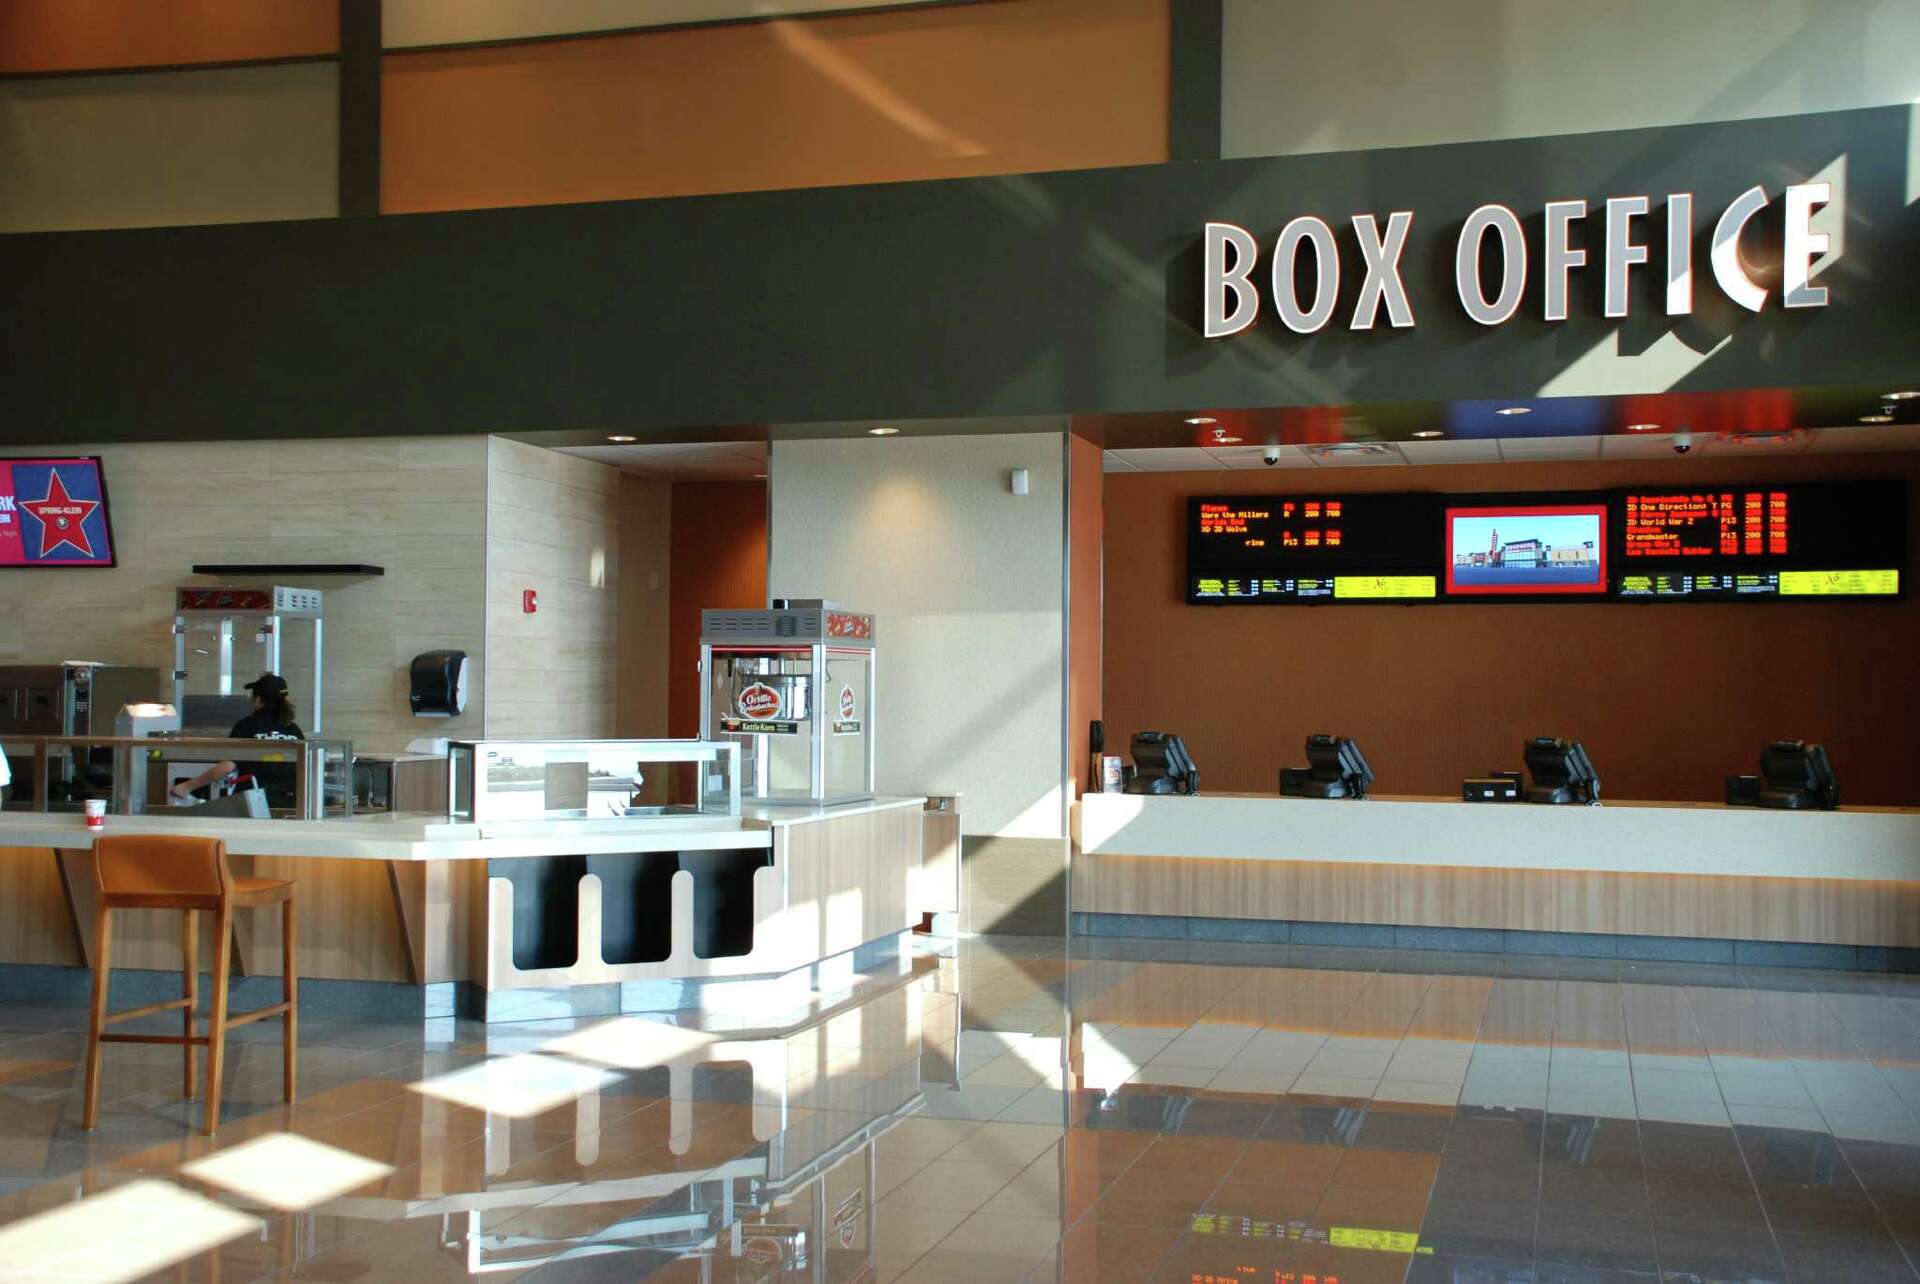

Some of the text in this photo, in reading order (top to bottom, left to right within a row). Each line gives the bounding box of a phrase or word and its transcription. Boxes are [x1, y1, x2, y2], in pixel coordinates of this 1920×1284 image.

[1204, 182, 1831, 338] BOX OFFICE
[1640, 503, 1656, 511] One
[1238, 511, 1269, 519] Millers
[1640, 518, 1665, 526] World
[1627, 533, 1679, 541] Grandmaster
[746, 694, 772, 705] Orville
[743, 723, 760, 731] Kettle
